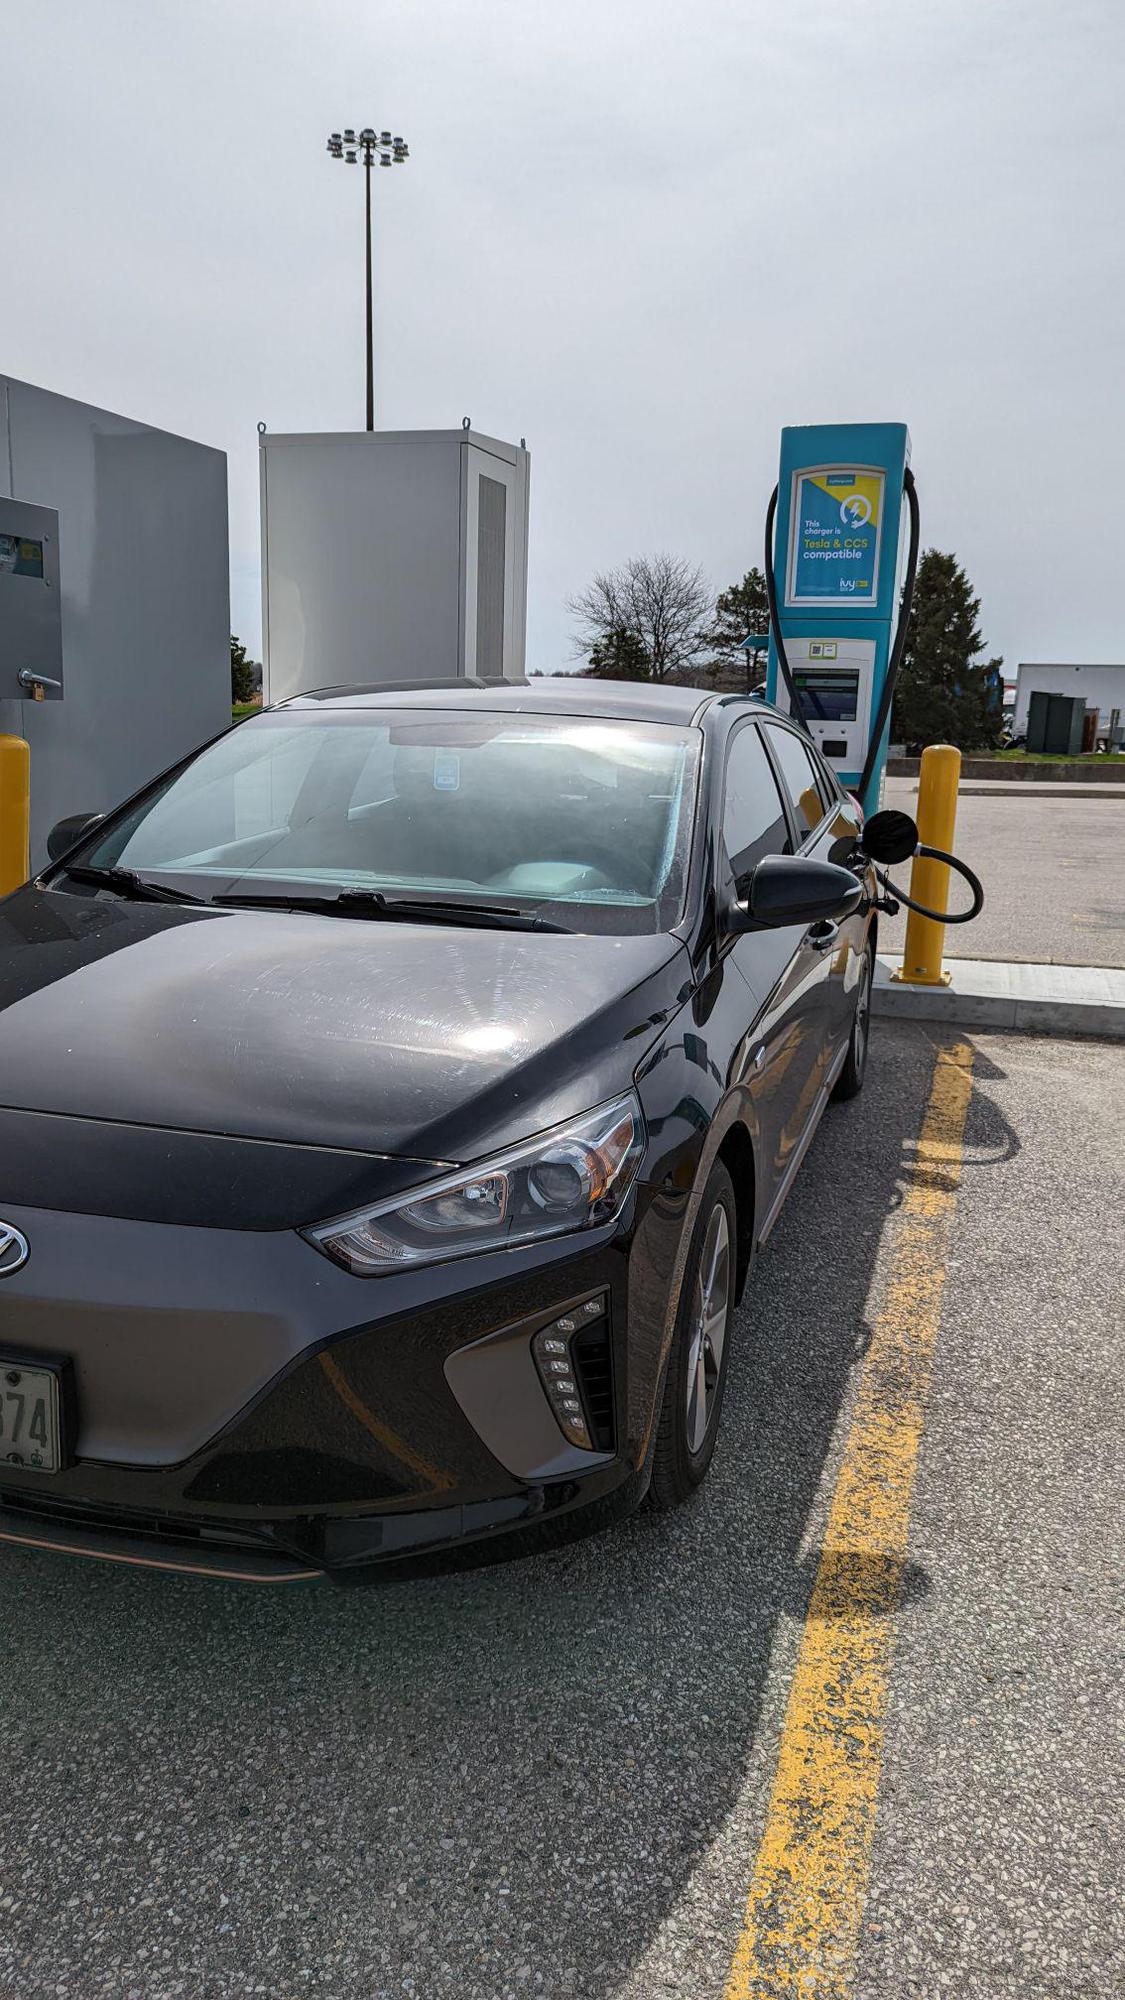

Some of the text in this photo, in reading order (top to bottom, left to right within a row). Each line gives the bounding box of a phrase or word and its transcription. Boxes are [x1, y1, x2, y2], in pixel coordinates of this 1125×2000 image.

[805, 520, 820, 528] This
[804, 527, 841, 536] charger is
[805, 538, 868, 549] Tesla & CCS
[803, 549, 862, 560] compatible
[840, 578, 855, 591] ivy
[0, 1392, 47, 1448] 74
